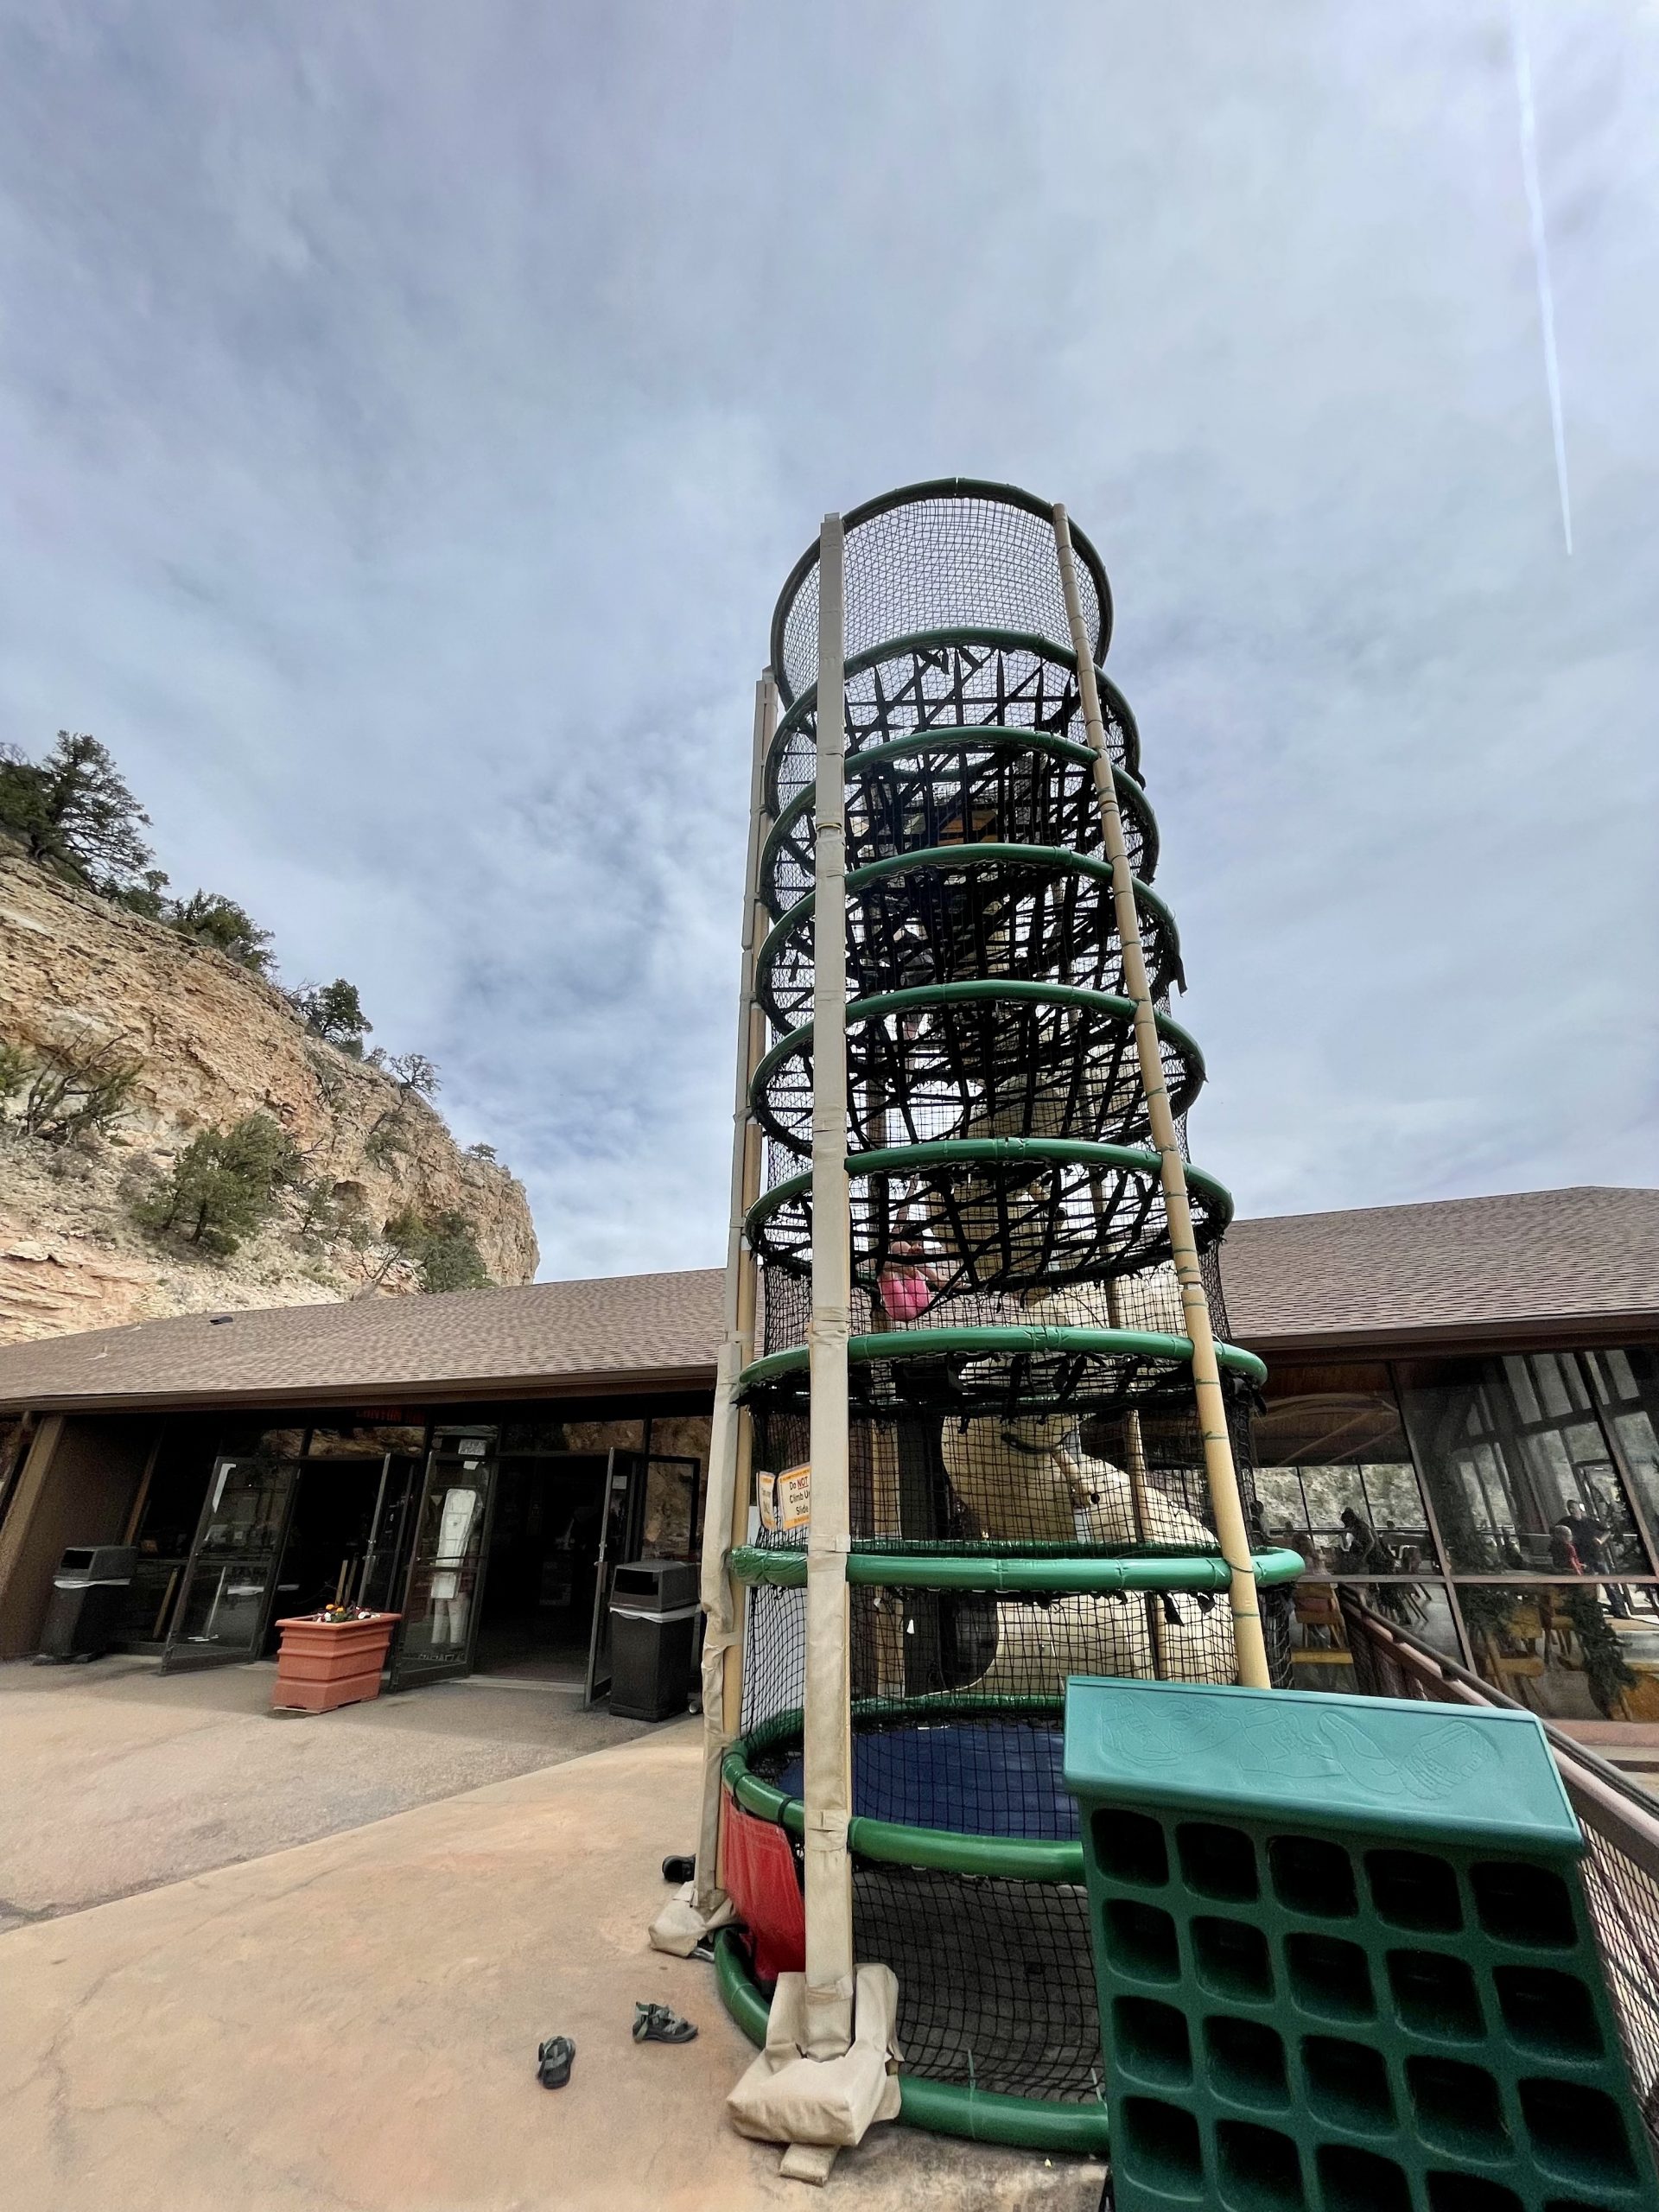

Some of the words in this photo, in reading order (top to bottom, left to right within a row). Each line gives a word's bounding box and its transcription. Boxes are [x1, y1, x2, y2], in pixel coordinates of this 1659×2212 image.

[789, 1481, 796, 1491] Do
[798, 1476, 808, 1488] NOT
[789, 1492, 804, 1503] Climb
[796, 1504, 809, 1515] Slide
